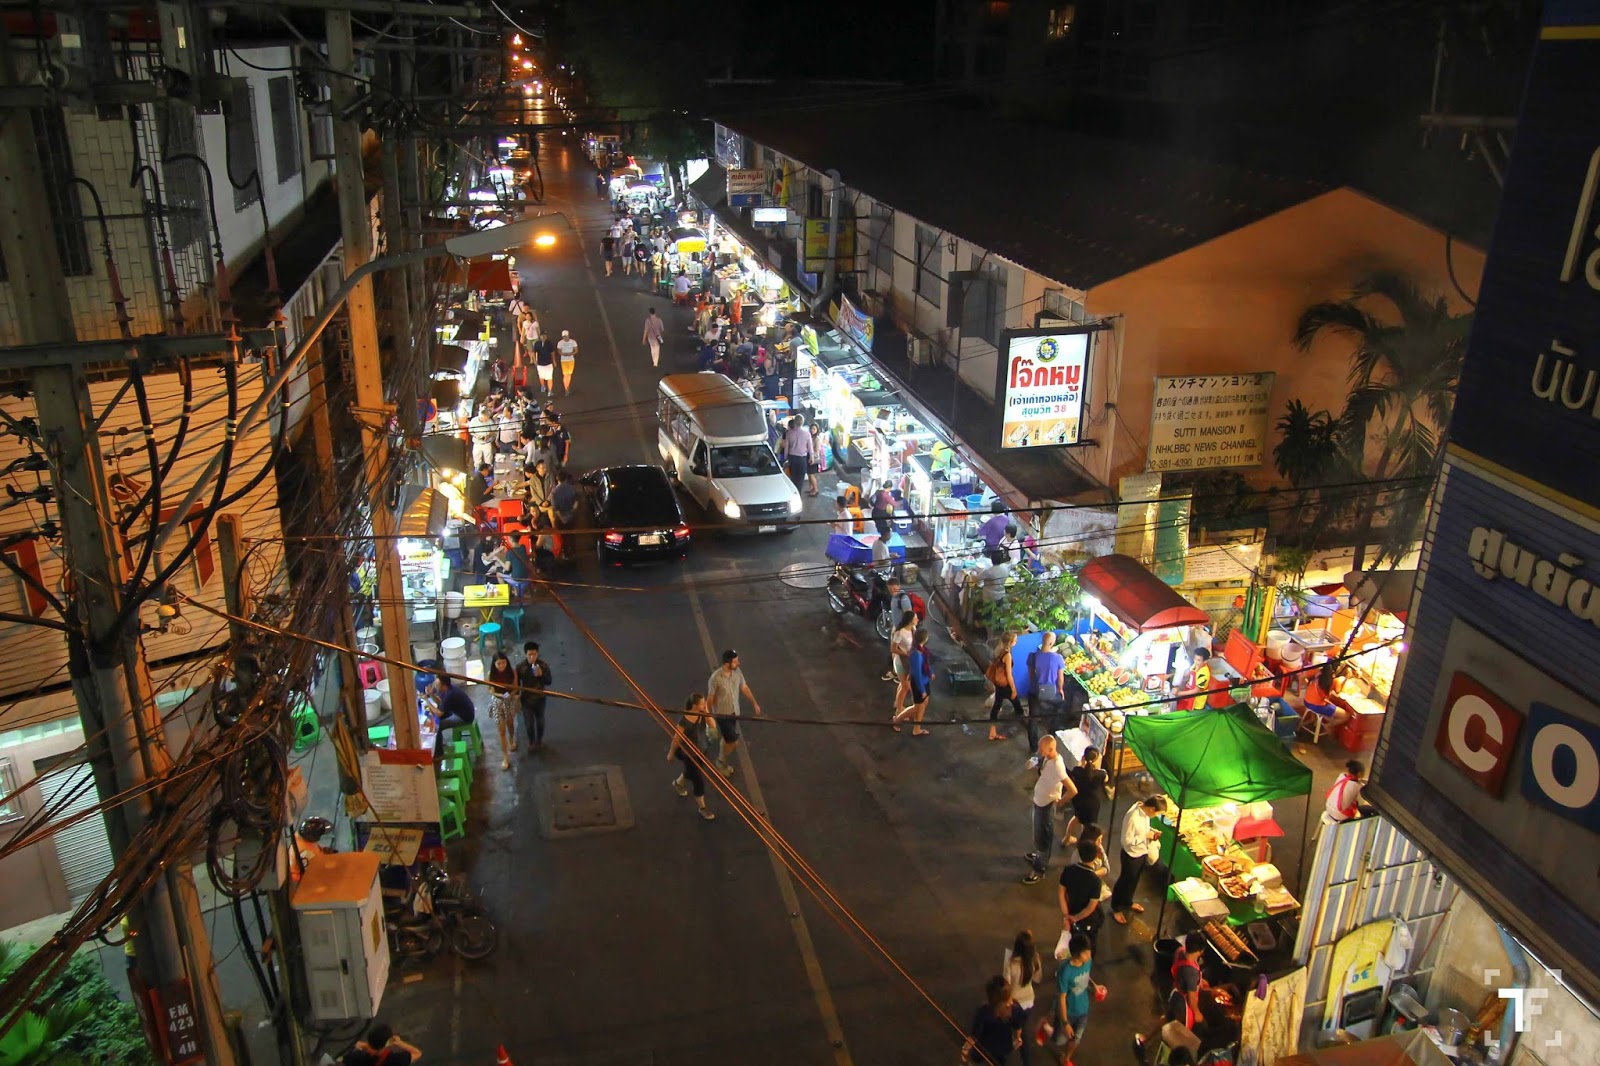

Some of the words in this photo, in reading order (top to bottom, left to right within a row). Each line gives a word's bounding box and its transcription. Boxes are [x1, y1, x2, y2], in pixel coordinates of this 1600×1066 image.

[1010, 356, 1081, 392] โจ๊กหมู
[1021, 404, 1051, 418] สุขุมวิท
[1054, 405, 1067, 414] 38
[1174, 427, 1197, 438] SUTTI
[1199, 425, 1237, 437] MANSION
[1194, 442, 1218, 452] NEWS
[1220, 439, 1257, 451] CHANNEL
[1196, 456, 1240, 467] 02-712-0111
[168, 1003, 189, 1020] EM
[169, 1015, 194, 1032] 423
